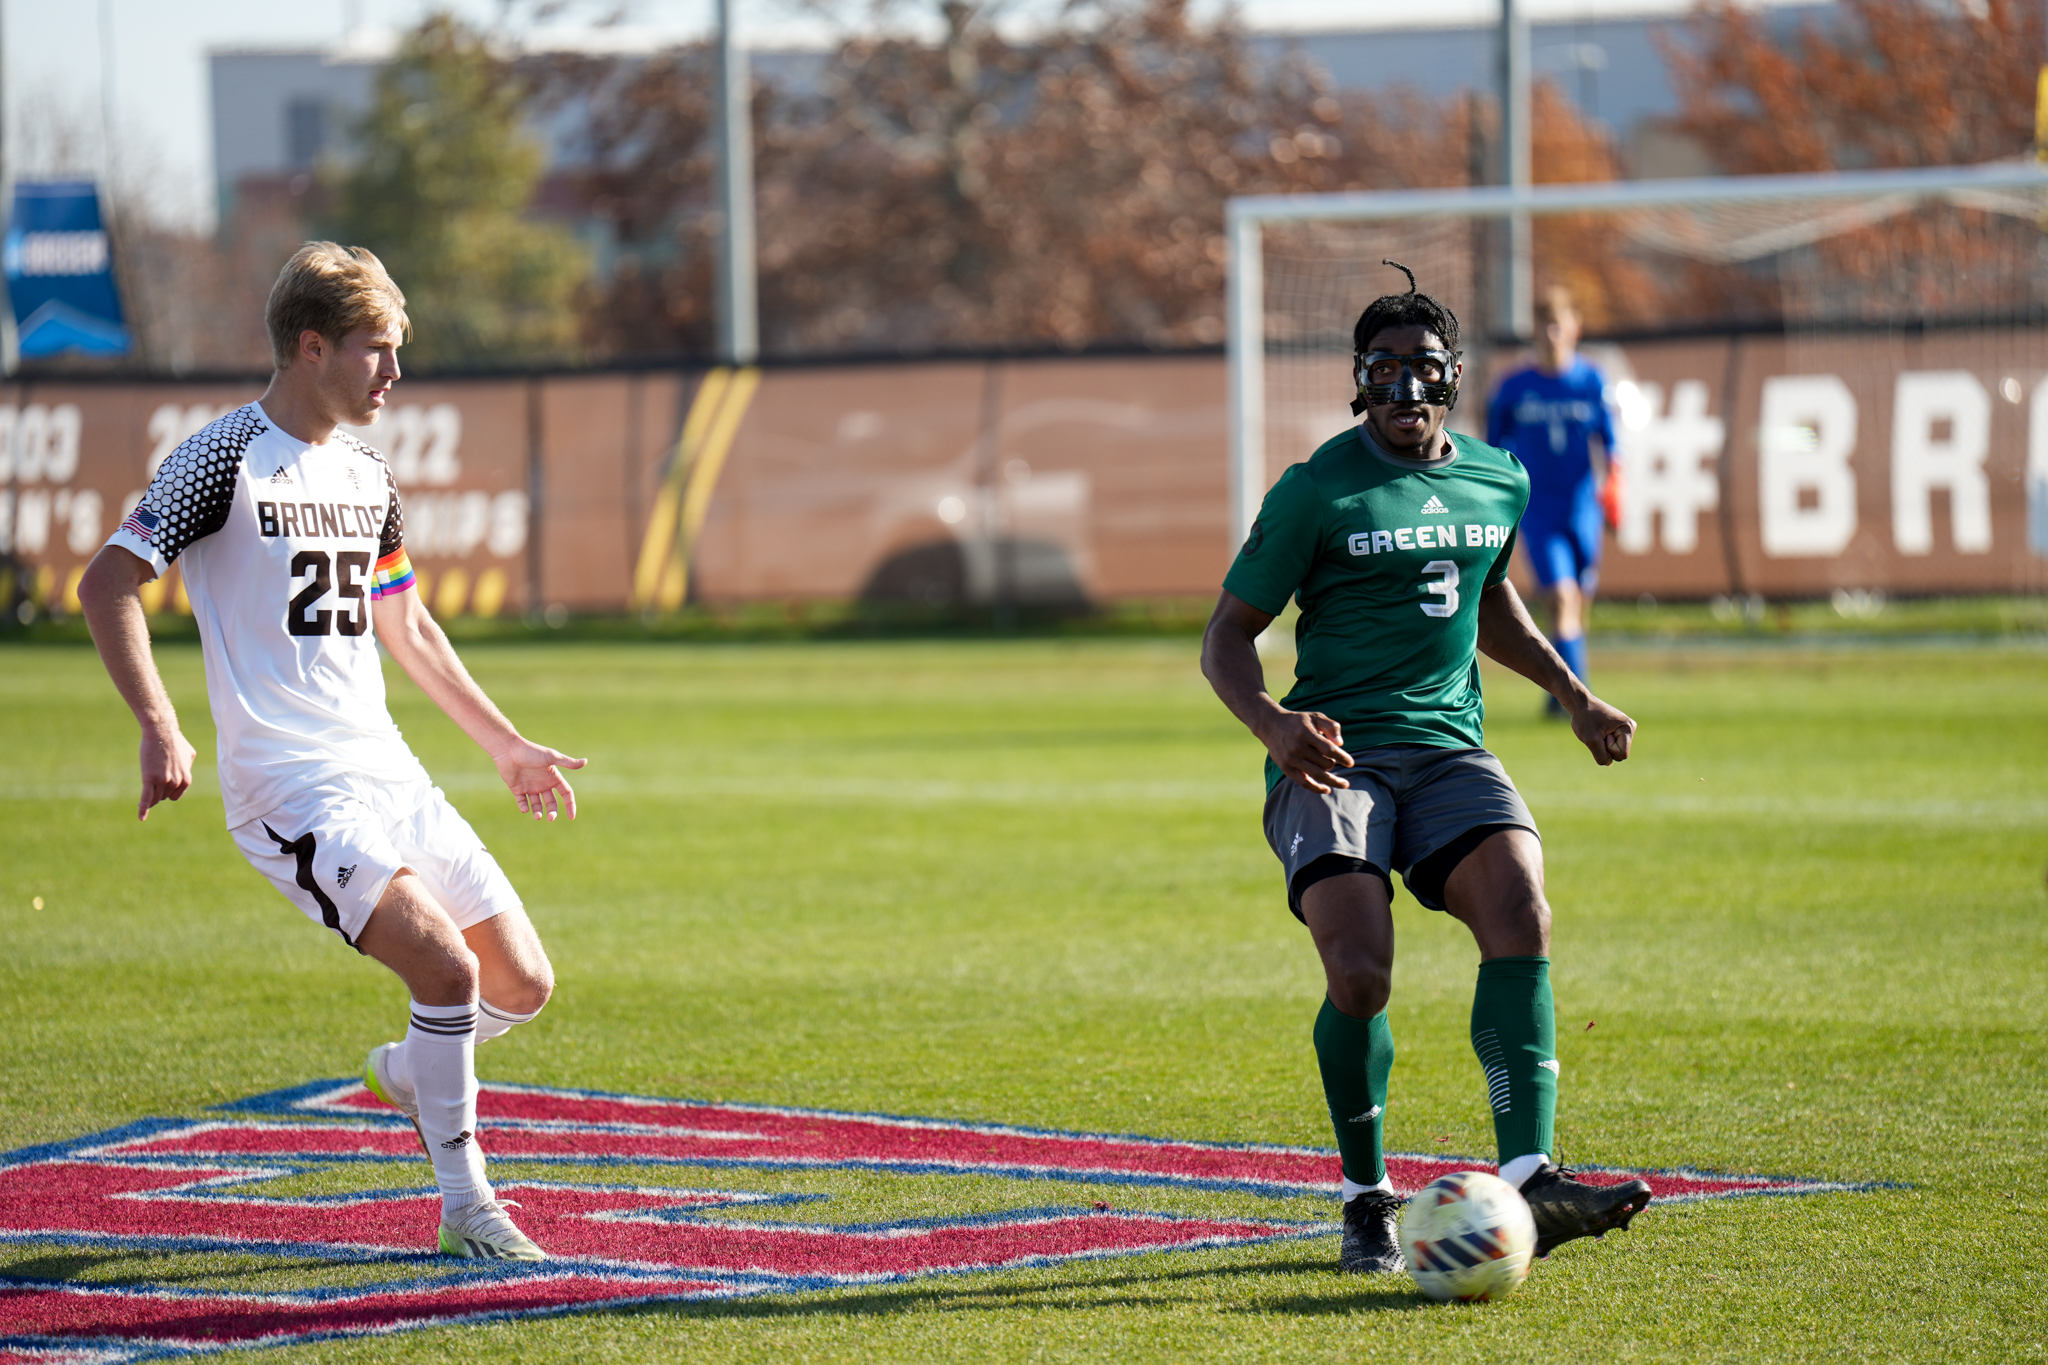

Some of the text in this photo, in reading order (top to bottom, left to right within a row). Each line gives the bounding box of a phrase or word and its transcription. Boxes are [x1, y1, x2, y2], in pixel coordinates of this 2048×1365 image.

[257, 501, 383, 539] BRONCOS
[1420, 506, 1450, 515] adidas
[1347, 524, 1510, 556] GREEN BAY
[288, 550, 371, 636] 25
[1419, 559, 1460, 618] 3
